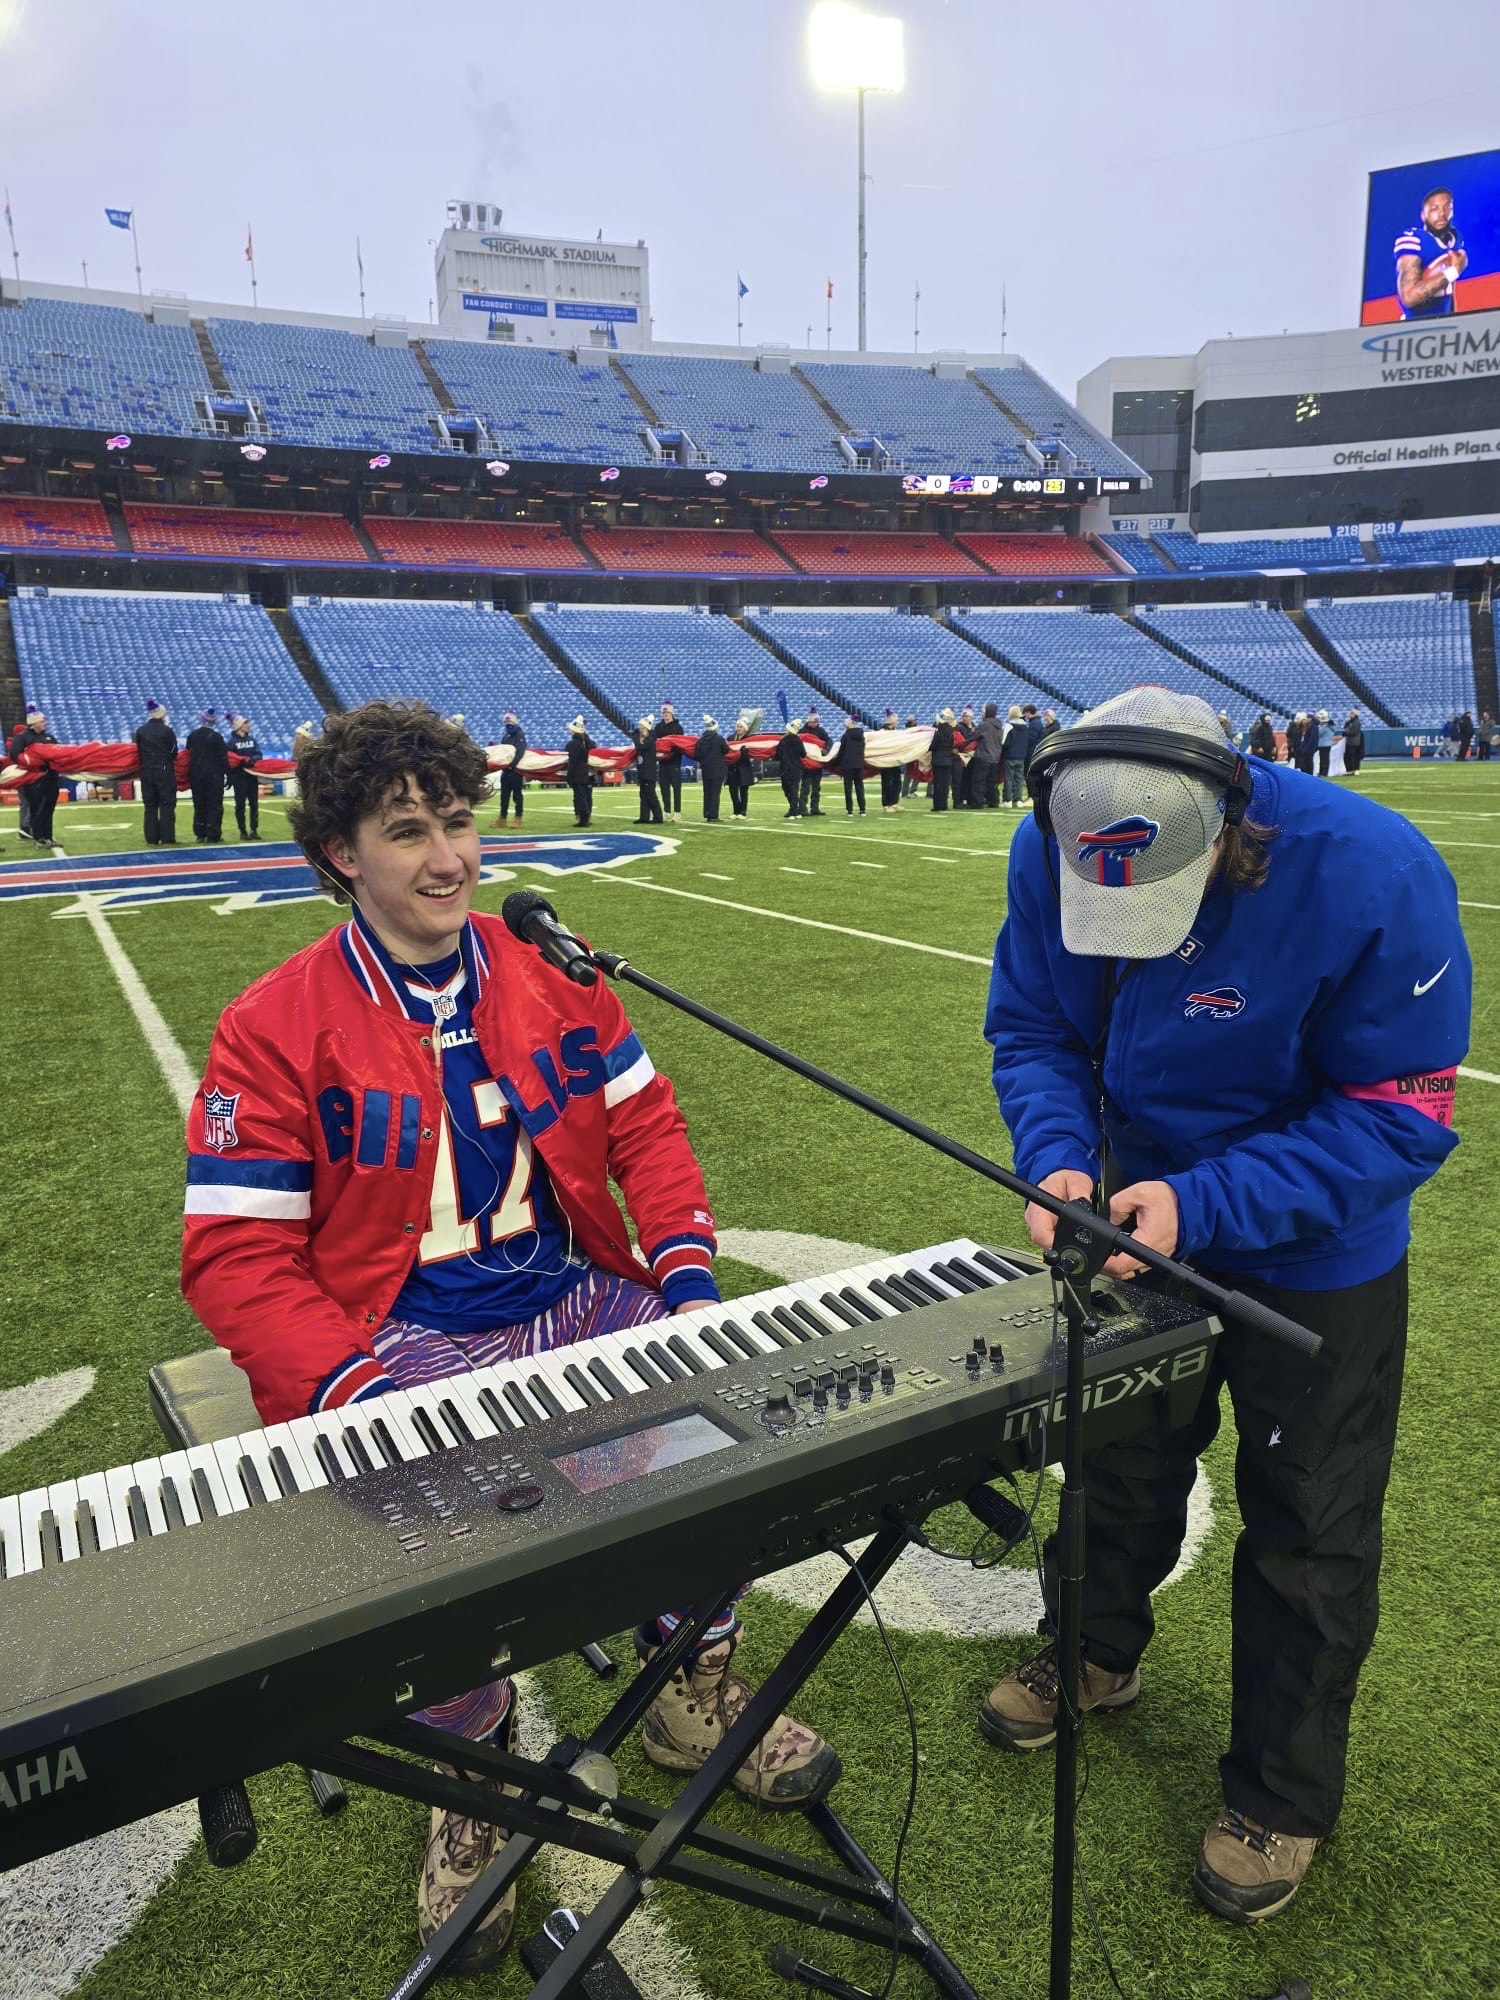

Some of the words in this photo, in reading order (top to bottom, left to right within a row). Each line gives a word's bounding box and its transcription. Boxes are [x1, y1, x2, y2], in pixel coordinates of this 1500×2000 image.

[489, 241, 557, 258] HIGHMARK
[563, 248, 616, 263] STADIUM
[480, 300, 513, 310] CONDUCT
[1381, 364, 1457, 382] WESTERN
[1462, 357, 1500, 374] NEW
[1333, 448, 1391, 466] Official
[1396, 443, 1449, 461] Health
[1454, 440, 1491, 456] Plan
[934, 479, 942, 489] 0
[982, 479, 990, 489] 0
[1013, 480, 1042, 492] 0:00
[1119, 520, 1138, 531] 217
[1149, 519, 1169, 530] 218
[1336, 524, 1359, 538] 218
[1373, 522, 1396, 535] 219
[1180, 941, 1196, 957] 3
[205, 1116, 234, 1145] NFL
[417, 1077, 538, 1268] 17
